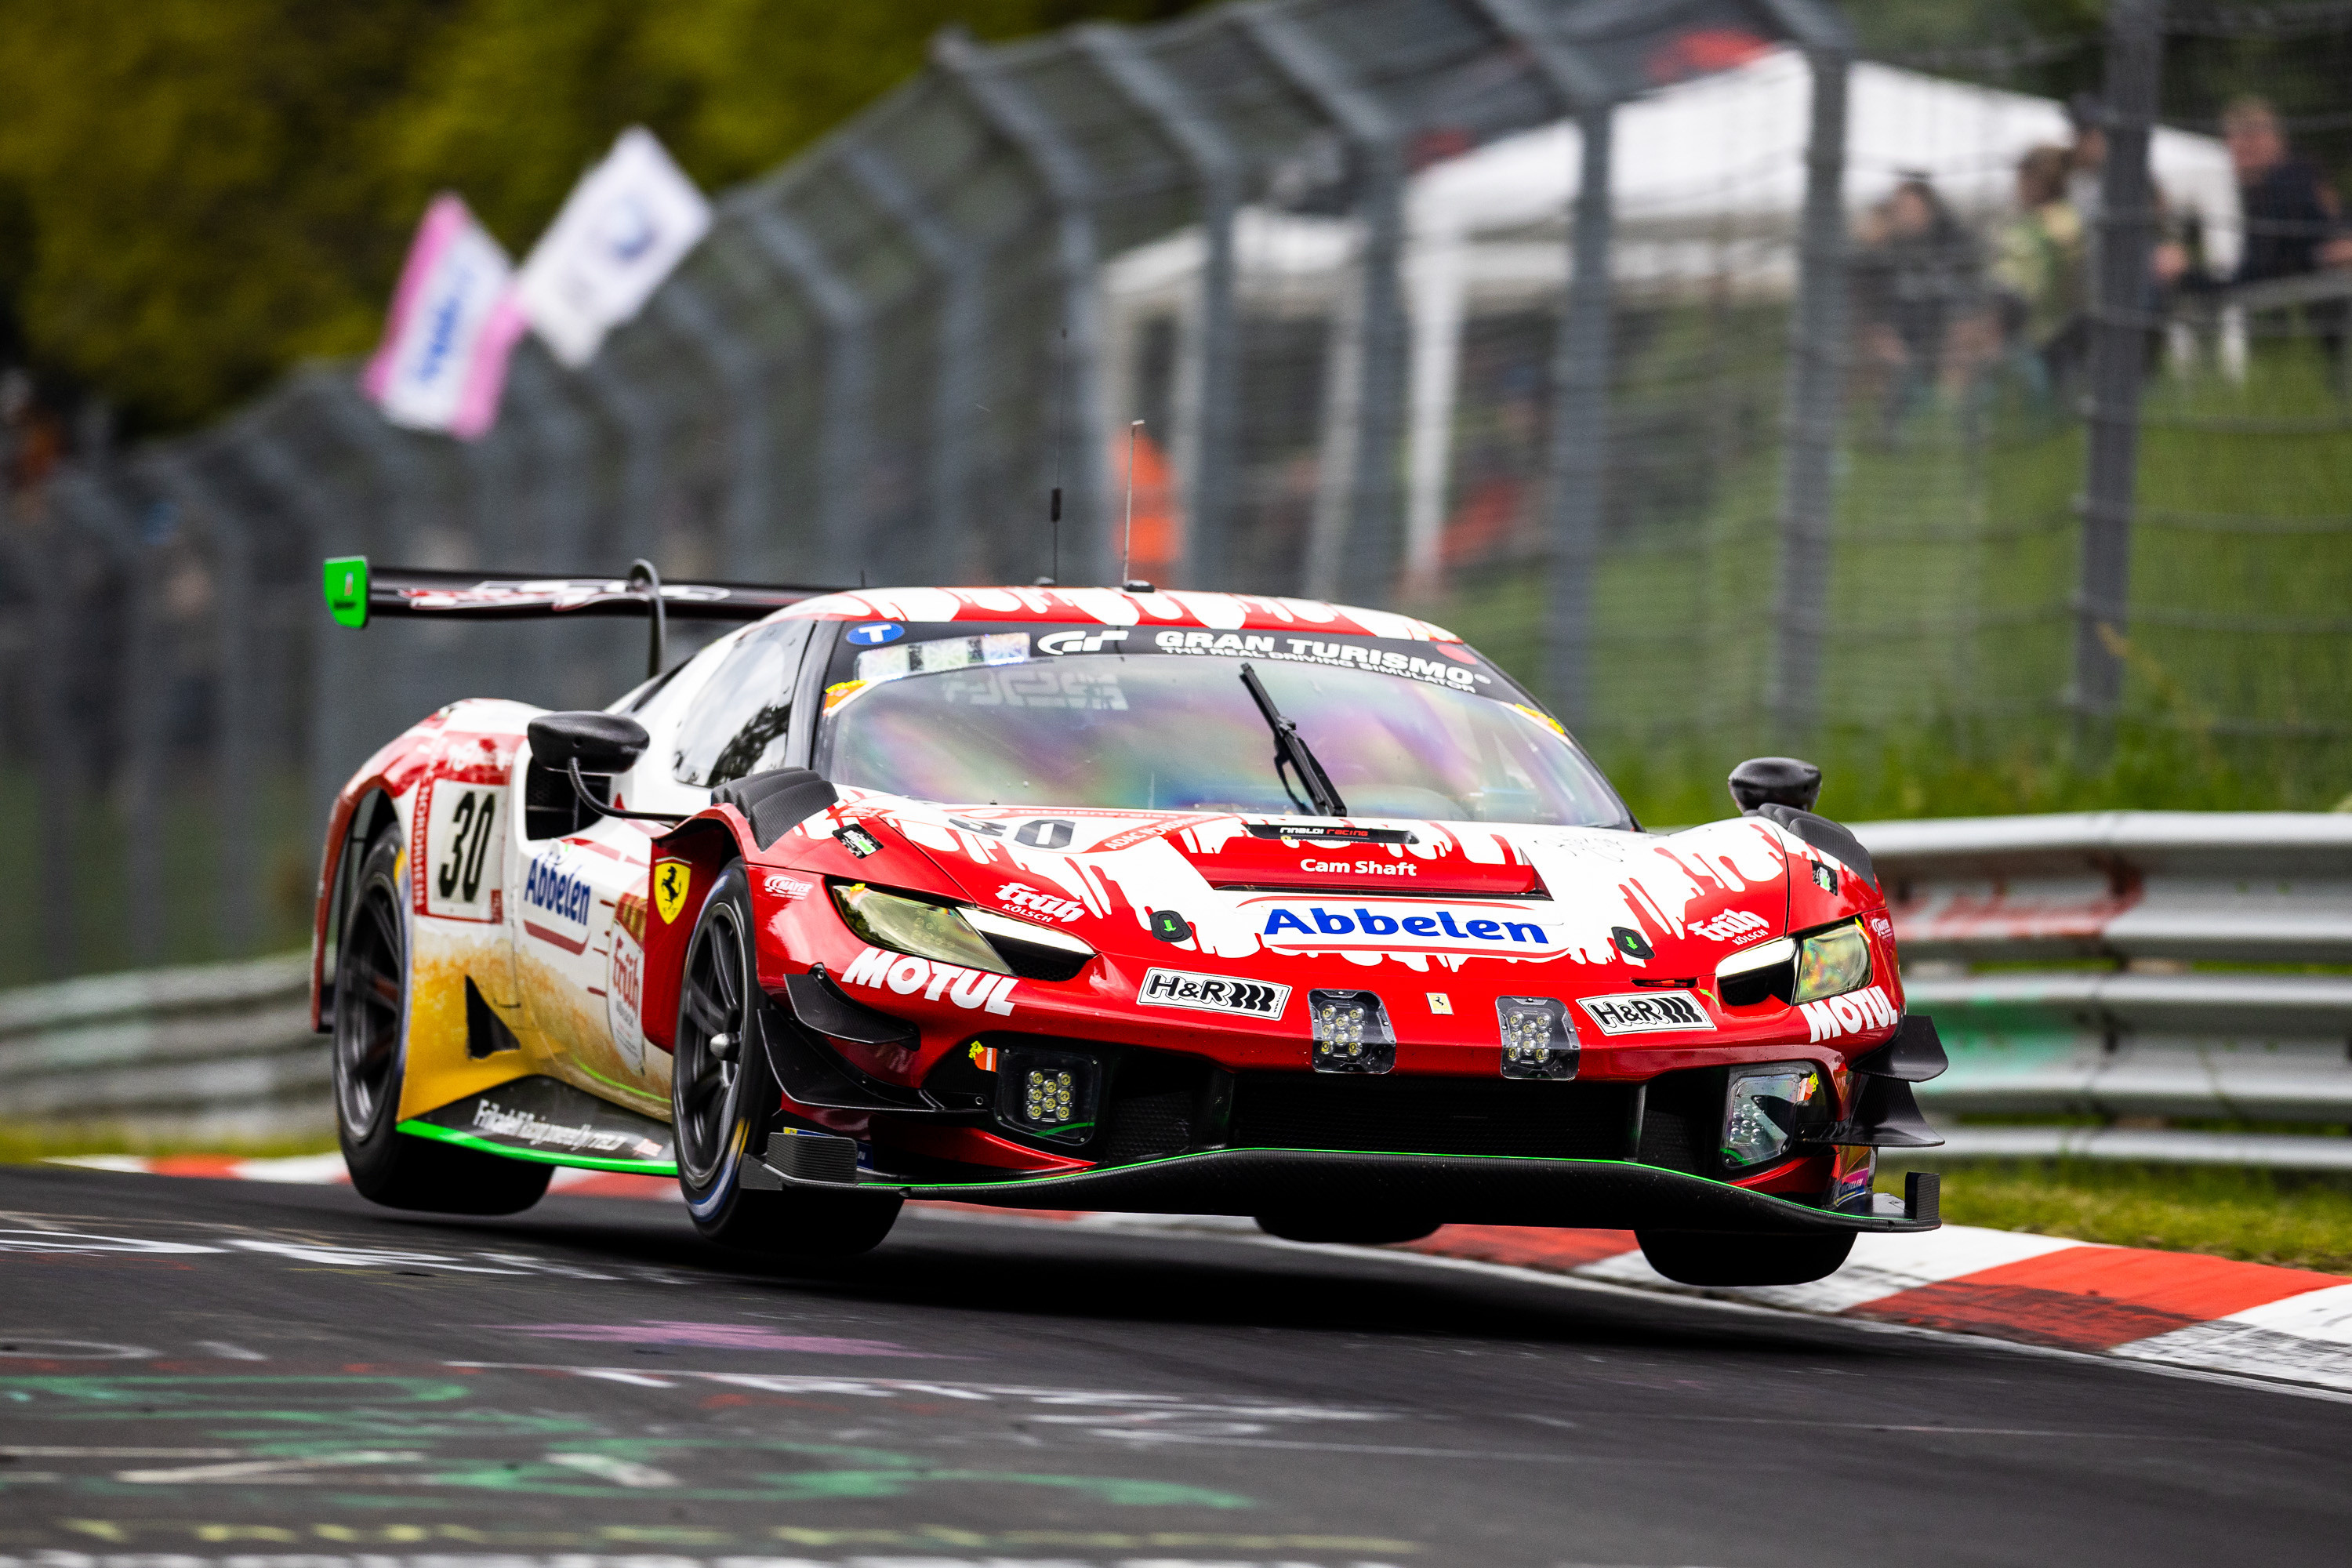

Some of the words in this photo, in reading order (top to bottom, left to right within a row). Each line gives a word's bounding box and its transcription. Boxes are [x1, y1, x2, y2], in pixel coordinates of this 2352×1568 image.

[1155, 630, 1275, 652] GRAN
[1161, 646, 1197, 655] THE
[1200, 648, 1265, 659] REAL
[1268, 651, 1357, 668] DRIVING
[1359, 662, 1476, 694] SIMULATOR
[438, 790, 495, 902] 30
[1104, 829, 1147, 850] ADAC
[1300, 858, 1351, 873] Cam
[1355, 861, 1417, 877] Shaft
[524, 854, 591, 926] Abbelen
[1002, 903, 1053, 923] KÖLSCH
[1263, 907, 1549, 944] Abbelen
[1732, 928, 1769, 946] KÖLSCH
[841, 946, 1020, 1017] MOTUL
[1149, 975, 1226, 1003] H&R
[1590, 1000, 1663, 1025] H&R
[1798, 985, 1898, 1044] MOTUL
